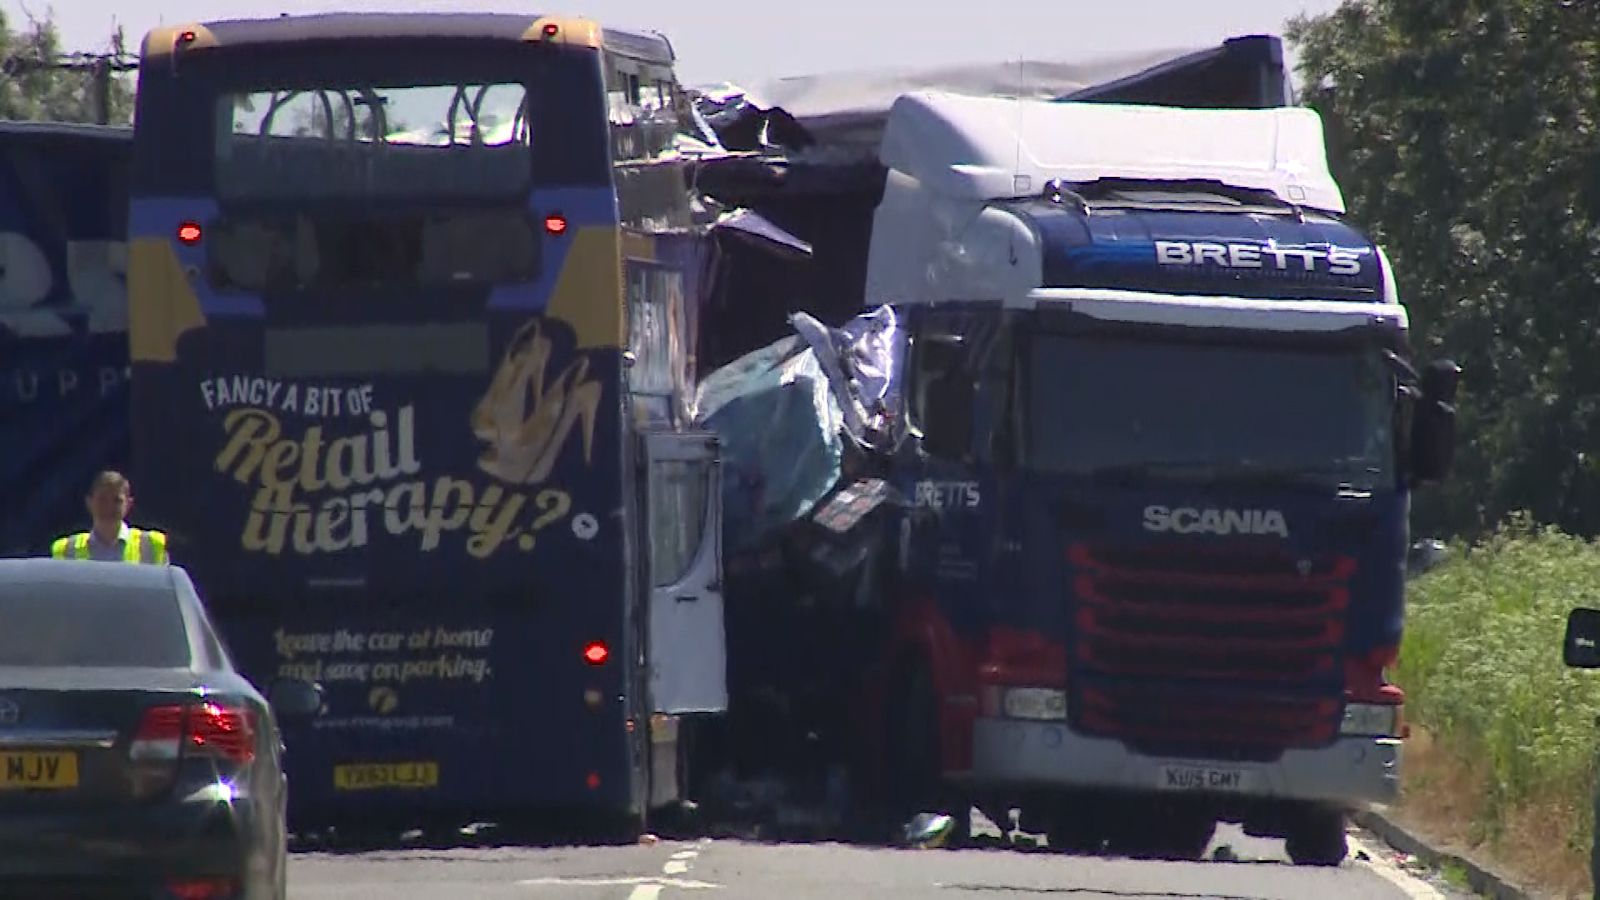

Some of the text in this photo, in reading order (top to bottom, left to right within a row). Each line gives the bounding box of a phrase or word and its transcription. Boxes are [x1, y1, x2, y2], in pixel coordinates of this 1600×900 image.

[1155, 240, 1362, 276] BRETTS
[200, 376, 376, 417] FANCY A BIT OF
[214, 406, 421, 491] Retail
[914, 480, 981, 508] BRETTS
[241, 472, 571, 556] therapy?
[1143, 505, 1289, 537] SCANIA
[333, 629, 365, 652] the
[368, 632, 404, 651] car
[408, 629, 430, 649] at
[433, 627, 494, 648] home
[279, 655, 492, 683] and save on parking.
[8, 755, 60, 781] MJV
